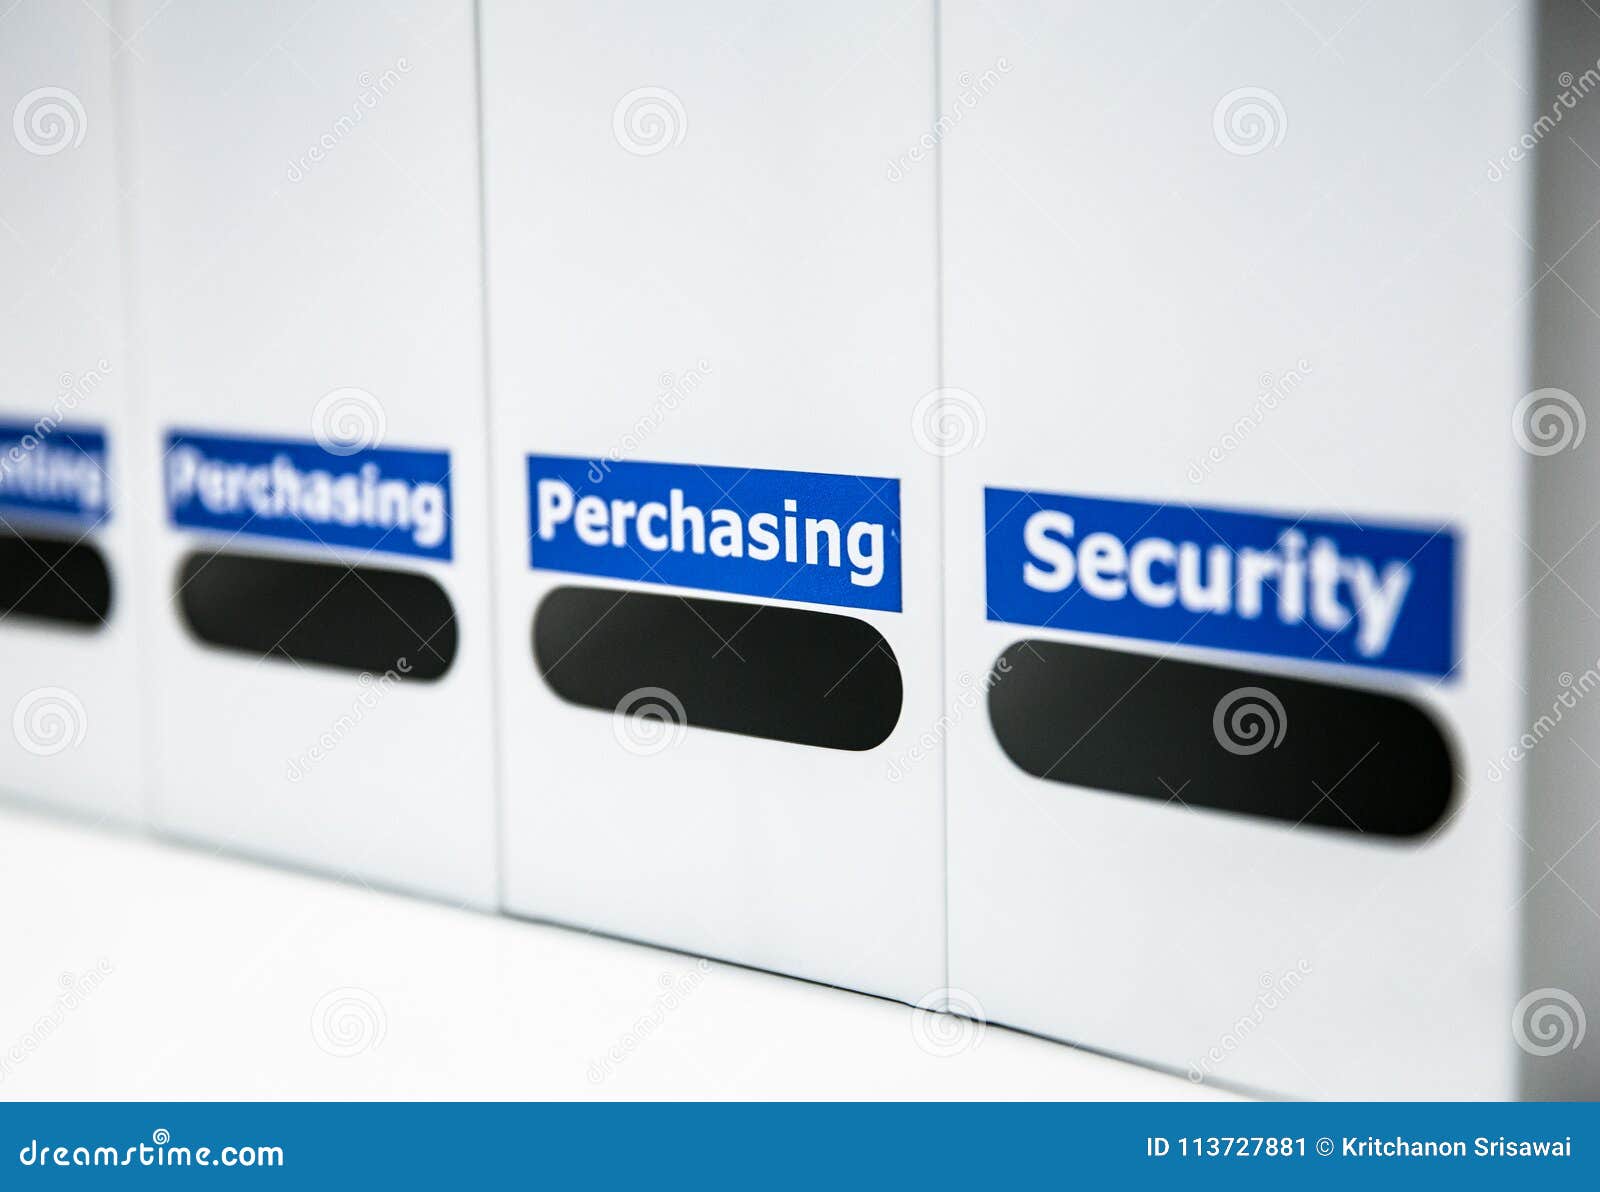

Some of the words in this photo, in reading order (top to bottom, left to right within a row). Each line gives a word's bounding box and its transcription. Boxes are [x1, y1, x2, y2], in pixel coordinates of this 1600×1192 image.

[168, 448, 446, 547] Perchasing
[537, 478, 885, 587] Perchasing
[1021, 509, 1412, 658] Security
